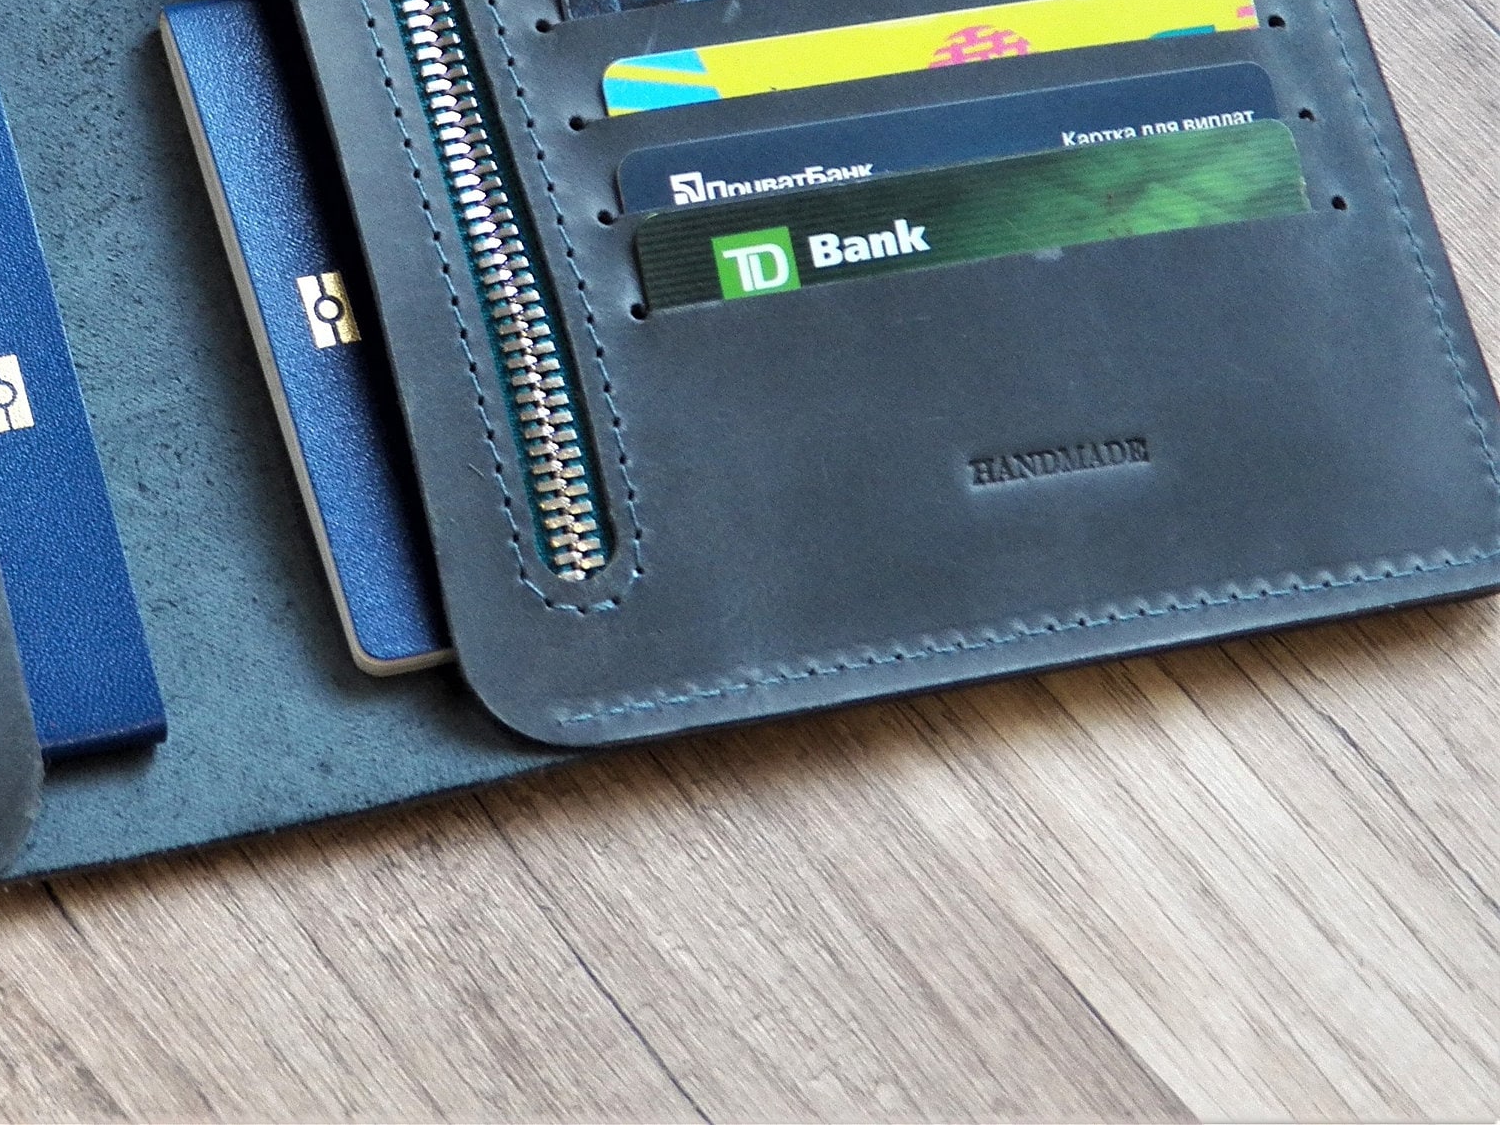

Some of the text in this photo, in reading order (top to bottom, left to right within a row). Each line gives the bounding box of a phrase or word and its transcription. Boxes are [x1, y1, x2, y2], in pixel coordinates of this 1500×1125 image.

[721, 218, 932, 292] TD Bank
[968, 436, 1151, 486] HANDMADE
